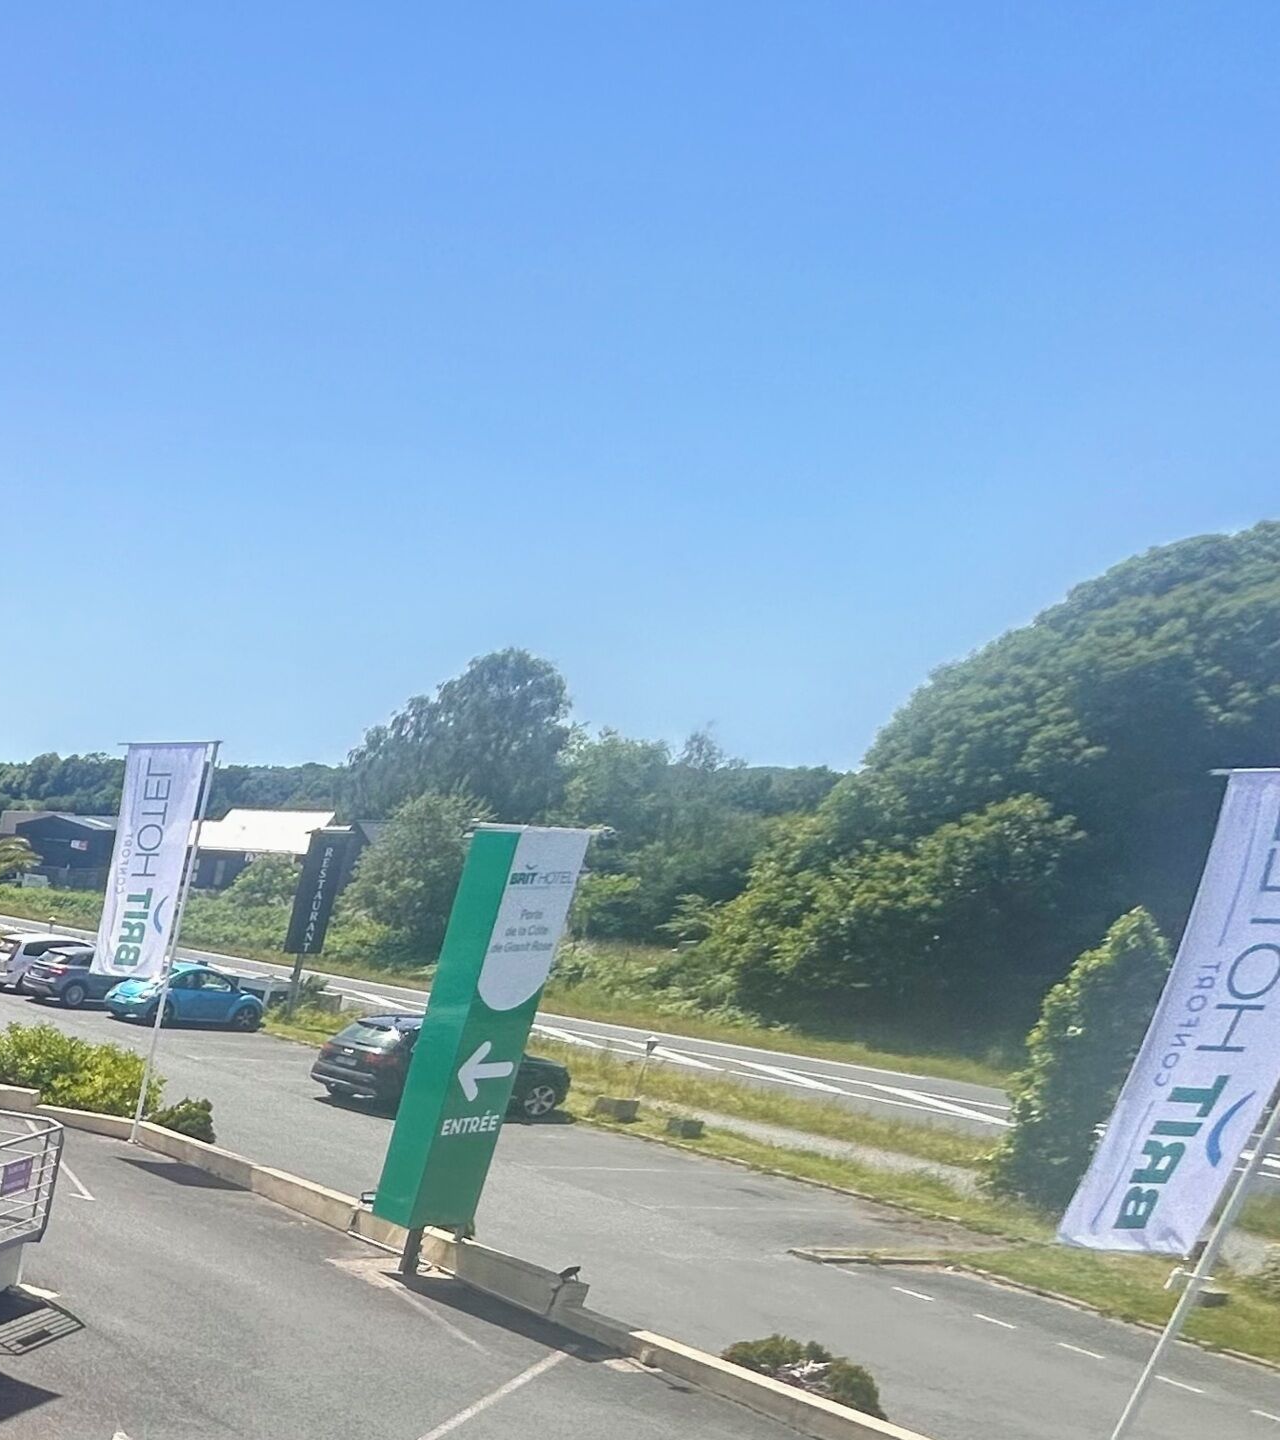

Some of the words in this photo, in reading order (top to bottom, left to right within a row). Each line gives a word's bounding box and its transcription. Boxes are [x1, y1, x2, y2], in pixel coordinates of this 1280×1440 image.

[509, 872, 538, 885] BRIT
[537, 871, 574, 884] HOTEL
[303, 847, 334, 952] RESTAURANT
[441, 1110, 499, 1135] ENTRÉE
